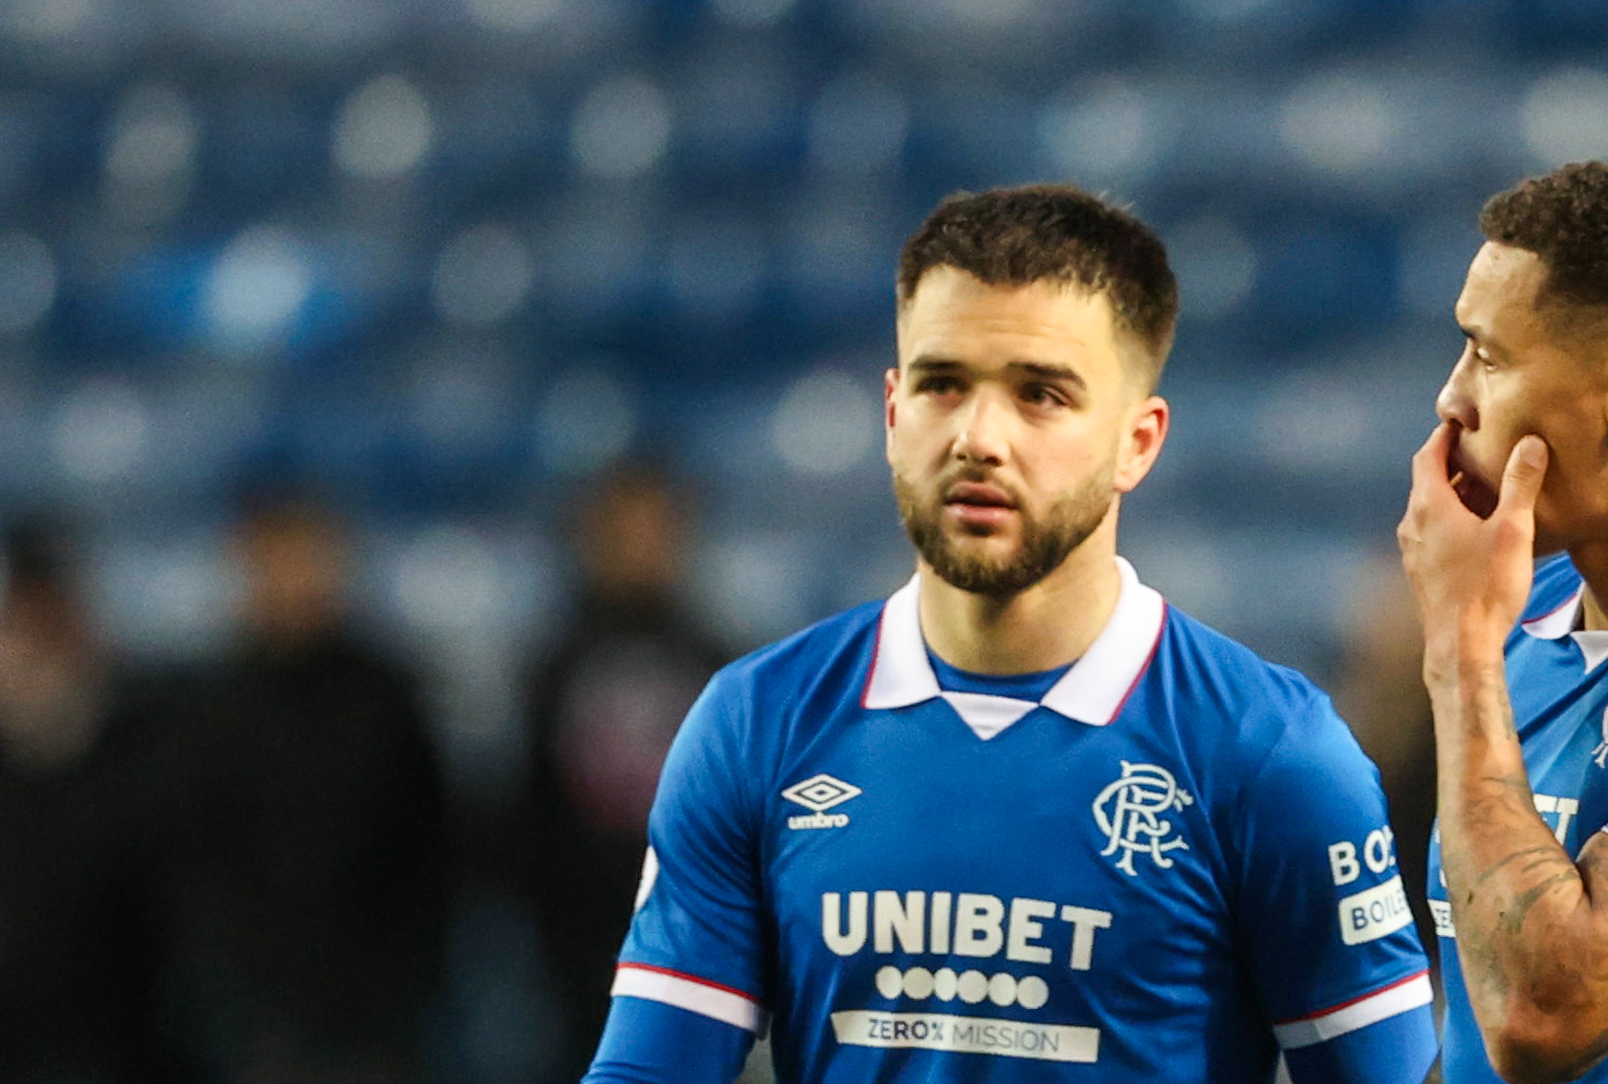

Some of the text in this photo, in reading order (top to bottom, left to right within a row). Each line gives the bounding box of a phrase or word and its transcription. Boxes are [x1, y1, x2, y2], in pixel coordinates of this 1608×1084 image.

[787, 812, 849, 830] umbro
[821, 890, 1112, 971] UNIBET
[952, 1024, 1060, 1053] MISSION
